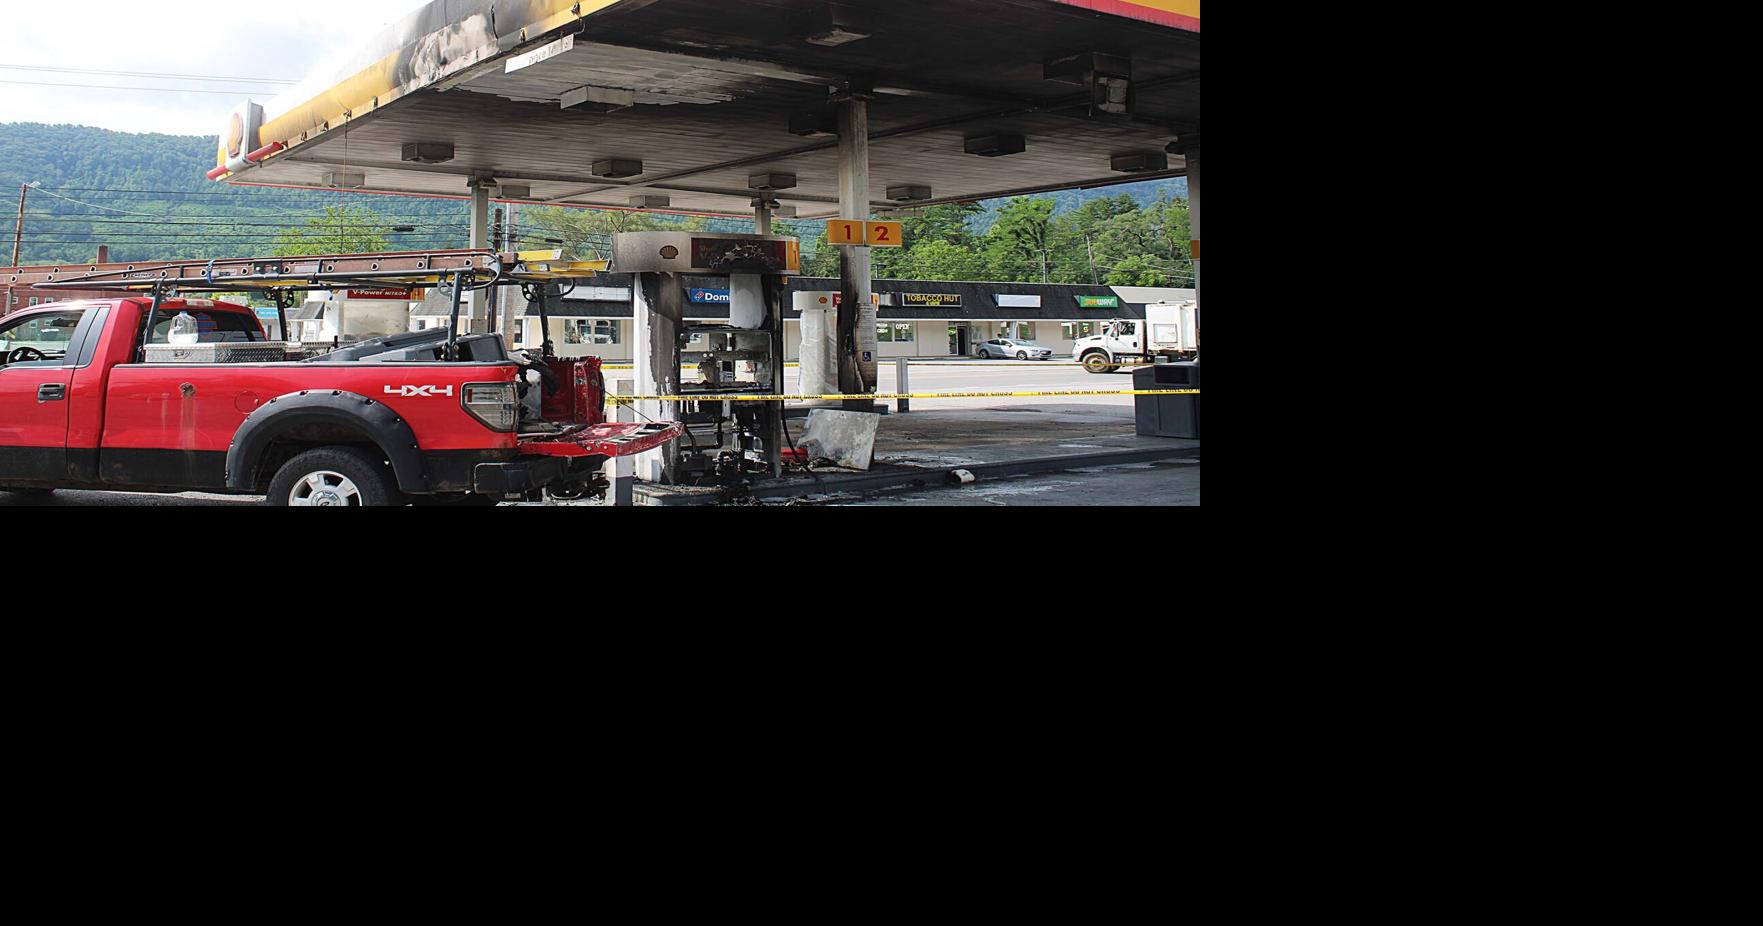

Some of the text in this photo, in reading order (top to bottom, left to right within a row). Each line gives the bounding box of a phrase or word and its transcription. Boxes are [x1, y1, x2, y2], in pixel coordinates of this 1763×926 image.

[844, 225, 851, 240] 1
[874, 226, 889, 240] 2
[907, 294, 943, 302] TOBACCO
